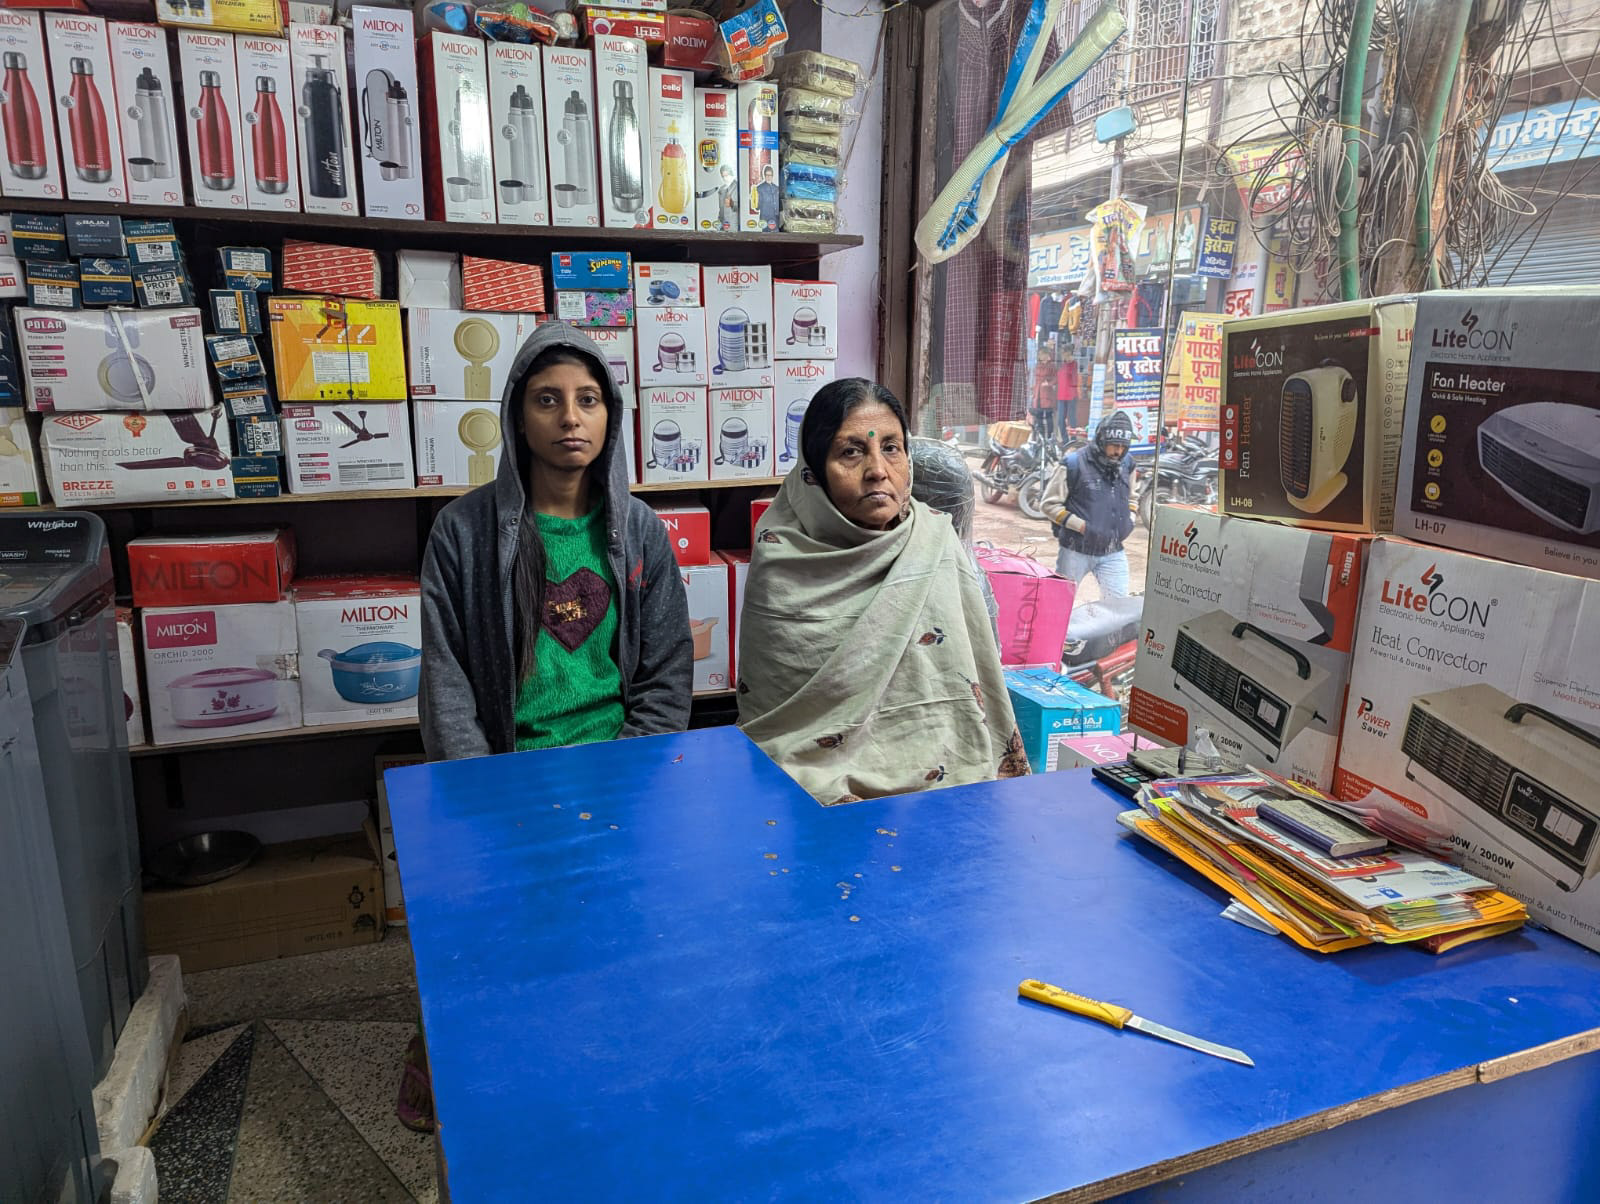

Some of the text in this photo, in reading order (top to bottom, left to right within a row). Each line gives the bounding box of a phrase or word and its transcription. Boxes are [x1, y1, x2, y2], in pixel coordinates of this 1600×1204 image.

[0, 15, 31, 28] ILTON
[55, 19, 98, 34] MILTON
[362, 19, 404, 34] MILTON
[117, 27, 157, 40] MILTON
[187, 34, 227, 48] MILTON
[244, 40, 282, 53] MILTON
[441, 41, 478, 56] MILTON
[603, 41, 640, 55] MILTON
[672, 36, 708, 49] MILTON
[495, 48, 533, 61] MILTON
[551, 54, 587, 67] MILTON
[662, 83, 681, 92] cello
[706, 102, 725, 110] cello
[374, 119, 385, 151] MILTON
[144, 273, 175, 282] WATER
[145, 280, 177, 291] PROFF
[791, 288, 822, 298] MILTON
[26, 320, 64, 330] POLAR
[587, 330, 618, 341] ILTON
[1432, 328, 1515, 351] LiteCON
[786, 366, 825, 377] MILTON
[1433, 372, 1506, 392] Fan Heater
[651, 391, 696, 404] MILON
[720, 390, 763, 401] MILTON
[1240, 397, 1252, 478] Fan Heater
[58, 446, 163, 459] Nothing cools better
[60, 462, 84, 473] than
[63, 480, 114, 491] BREEZE
[1231, 497, 1253, 508] LH-08
[28, 520, 78, 532] Whirlpool
[1415, 518, 1446, 535] LH-07
[1160, 534, 1225, 568] LiteCON
[1544, 546, 1599, 566] Believe in you
[136, 560, 271, 592] MILTON
[1155, 571, 1222, 604] Heat Convector
[1381, 580, 1490, 629] LiteCON
[341, 604, 408, 624] MILTON
[1010, 582, 1042, 666] MILTON
[1379, 604, 1486, 640] Electronic Home Appliances
[156, 622, 208, 638] MILTON
[1145, 628, 1166, 652] POWER
[154, 648, 214, 660] ORCHID 2000
[1147, 648, 1164, 660] Saver
[1371, 625, 1489, 676] Heat Convector
[1370, 647, 1398, 661] Powerful
[1406, 659, 1432, 673] Durable
[1533, 671, 1600, 698] Superior Perform
[1552, 689, 1600, 711] Meets Elega
[1357, 696, 1391, 731] POWER
[1361, 721, 1389, 740] Saver
[1220, 737, 1244, 752] 2000W
[1479, 847, 1515, 870] 2000W
[1506, 887, 1536, 905] Control
[1537, 900, 1545, 910] &
[1546, 904, 1567, 921] Auto
